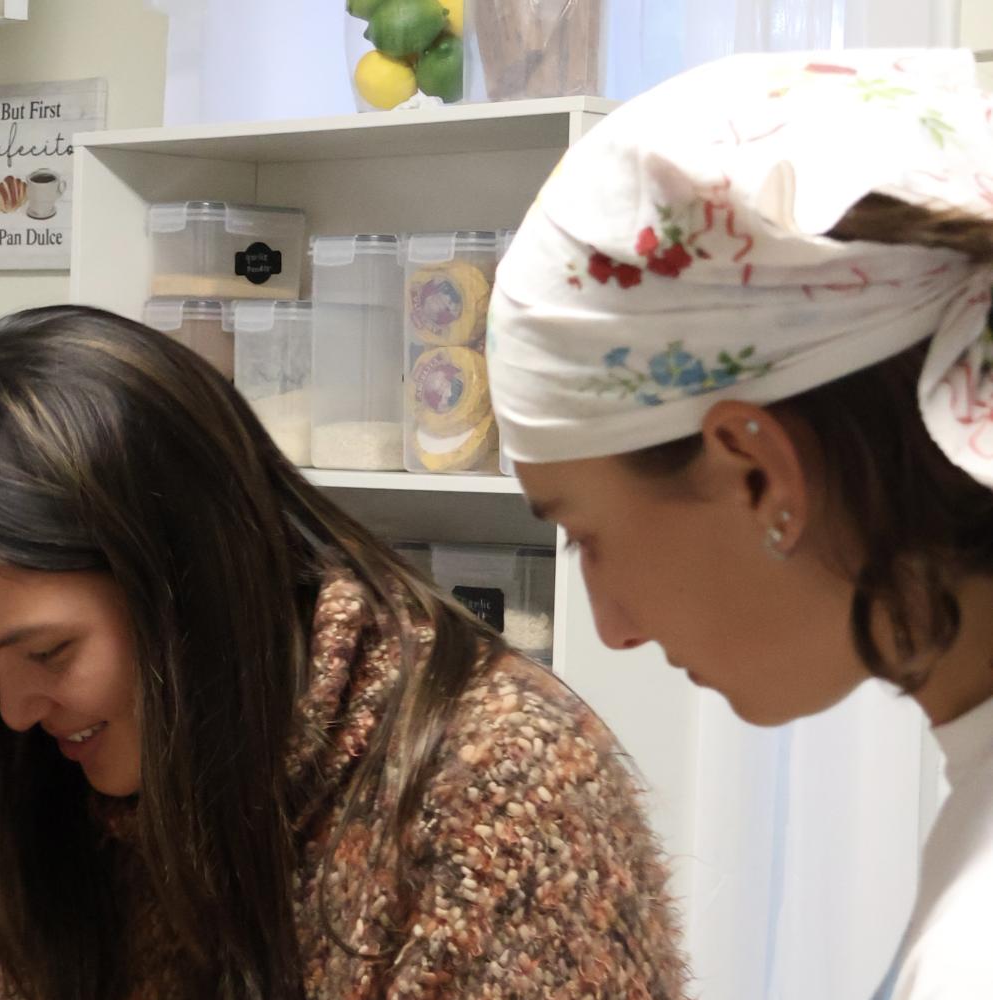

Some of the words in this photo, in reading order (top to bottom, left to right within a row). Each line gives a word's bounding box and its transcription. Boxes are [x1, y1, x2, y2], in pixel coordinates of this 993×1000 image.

[1, 102, 25, 121] But
[29, 100, 61, 119] First
[26, 227, 63, 246] Dulce
